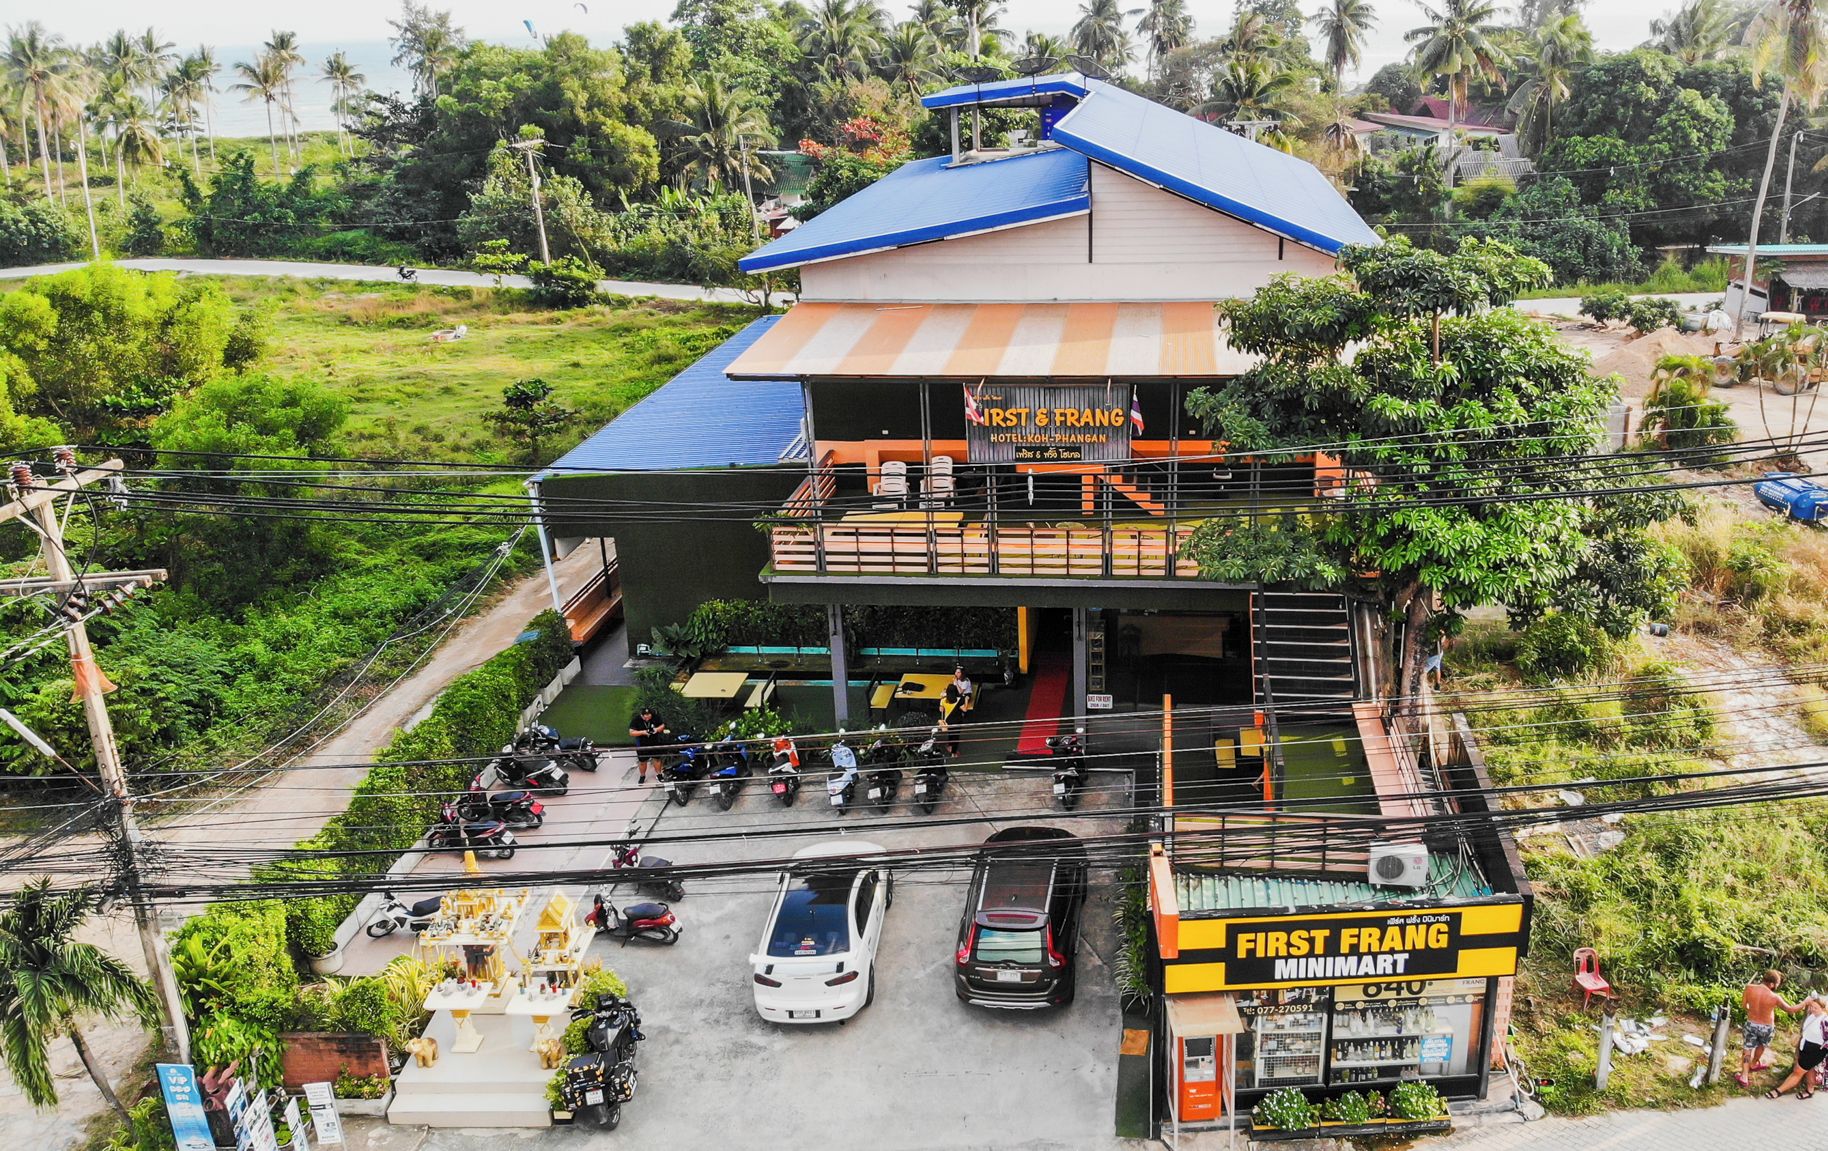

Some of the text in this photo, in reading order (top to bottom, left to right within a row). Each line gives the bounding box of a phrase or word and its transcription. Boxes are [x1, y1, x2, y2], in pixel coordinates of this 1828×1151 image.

[973, 407, 1125, 427] IRST & FRANG
[1237, 923, 1449, 958] FIRST FRANG
[1274, 953, 1409, 980] MINIMART
[1256, 1004, 1314, 1015] 077-270591
